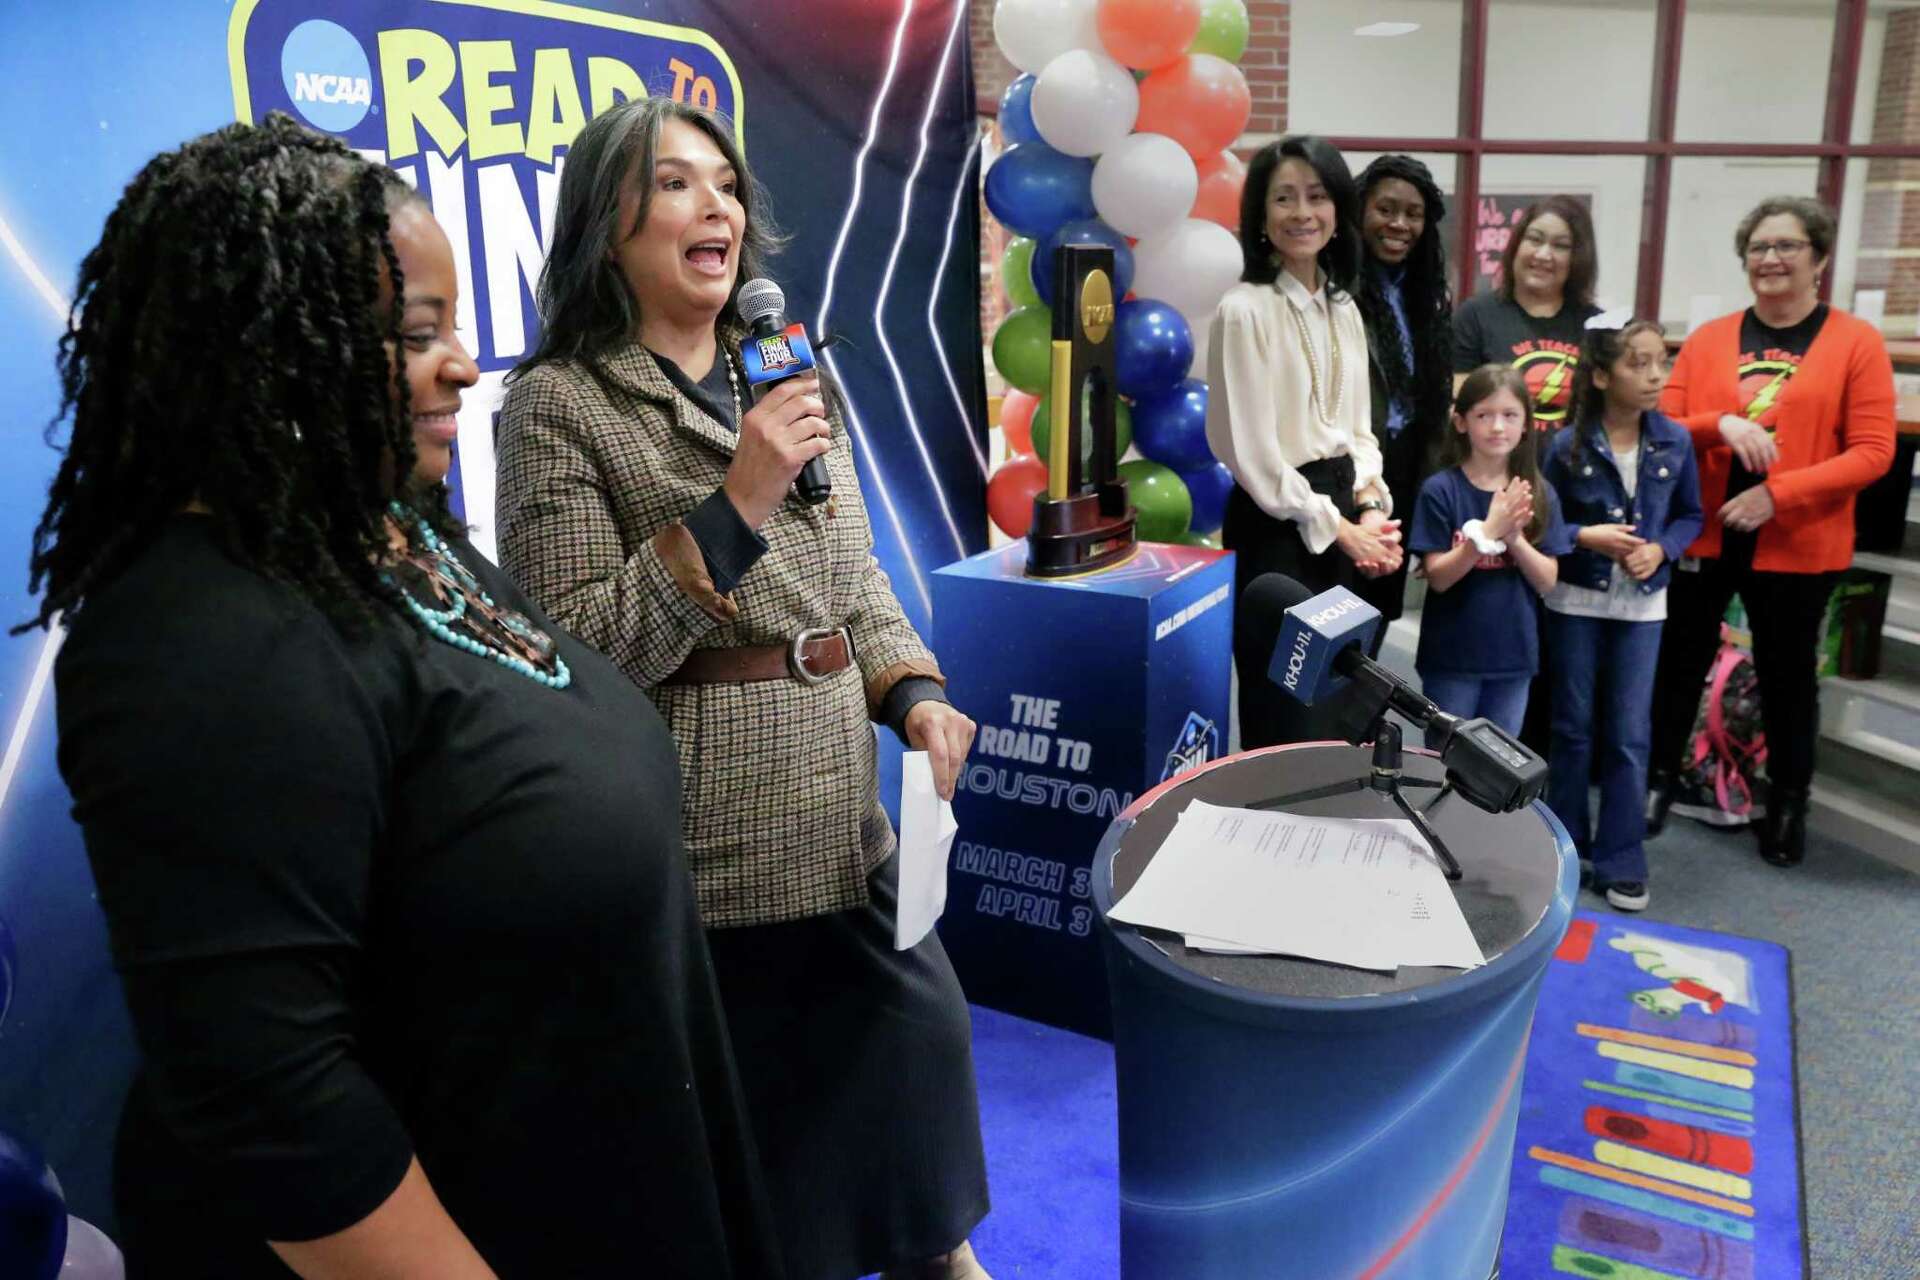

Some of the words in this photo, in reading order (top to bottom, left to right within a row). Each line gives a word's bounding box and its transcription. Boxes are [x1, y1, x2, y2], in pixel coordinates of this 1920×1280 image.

[295, 72, 371, 106] NCAA
[669, 57, 717, 112] TO
[761, 340, 788, 355] FINAL
[764, 351, 791, 364] FOUR
[1010, 693, 1061, 730] THE
[979, 725, 1051, 764] ROAD
[1056, 738, 1093, 772] TO
[956, 841, 1066, 893] MARCH
[976, 884, 1062, 930] APRIL
[1068, 905, 1093, 937] 3
